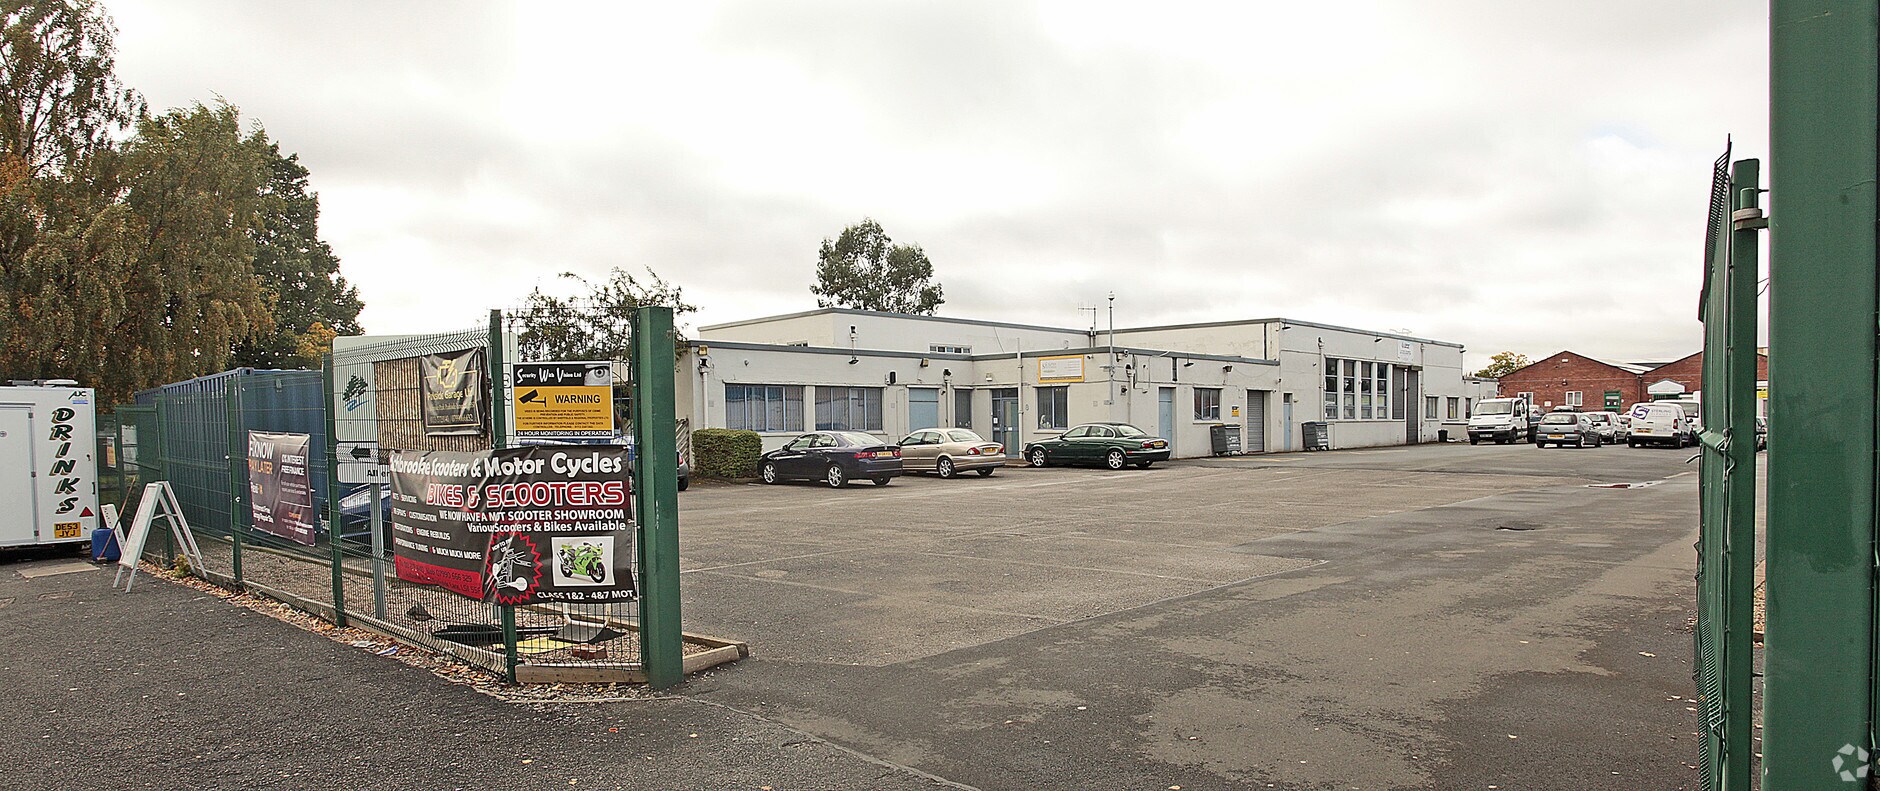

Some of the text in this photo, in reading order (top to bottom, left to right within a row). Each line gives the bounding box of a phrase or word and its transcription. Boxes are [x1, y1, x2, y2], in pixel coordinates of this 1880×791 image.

[517, 368, 536, 383] Security
[539, 368, 554, 382] With
[557, 368, 573, 382] Vision
[445, 390, 463, 400] Garage
[555, 395, 600, 403] WARNING
[49, 408, 80, 514] DRINKS
[431, 457, 469, 477] Scooters
[471, 458, 481, 478] &
[484, 457, 544, 478] Motor
[551, 452, 622, 478] Cycles
[426, 482, 624, 508] BIKES & SCOOTERS
[439, 510, 448, 520] WE
[448, 510, 461, 521] NOW
[462, 512, 480, 522] HAVE
[481, 512, 488, 522] A
[508, 510, 552, 521] SCOOTER
[554, 509, 624, 520] SHOWROOM
[55, 522, 78, 531] DE53
[534, 523, 542, 532] &
[544, 521, 572, 532] Bikes
[574, 519, 626, 531] Available
[430, 530, 450, 540] REBUILDS
[436, 547, 449, 556] MUCH
[449, 548, 463, 558] MUCH
[464, 551, 482, 560] MORE
[612, 590, 633, 598] MOT
